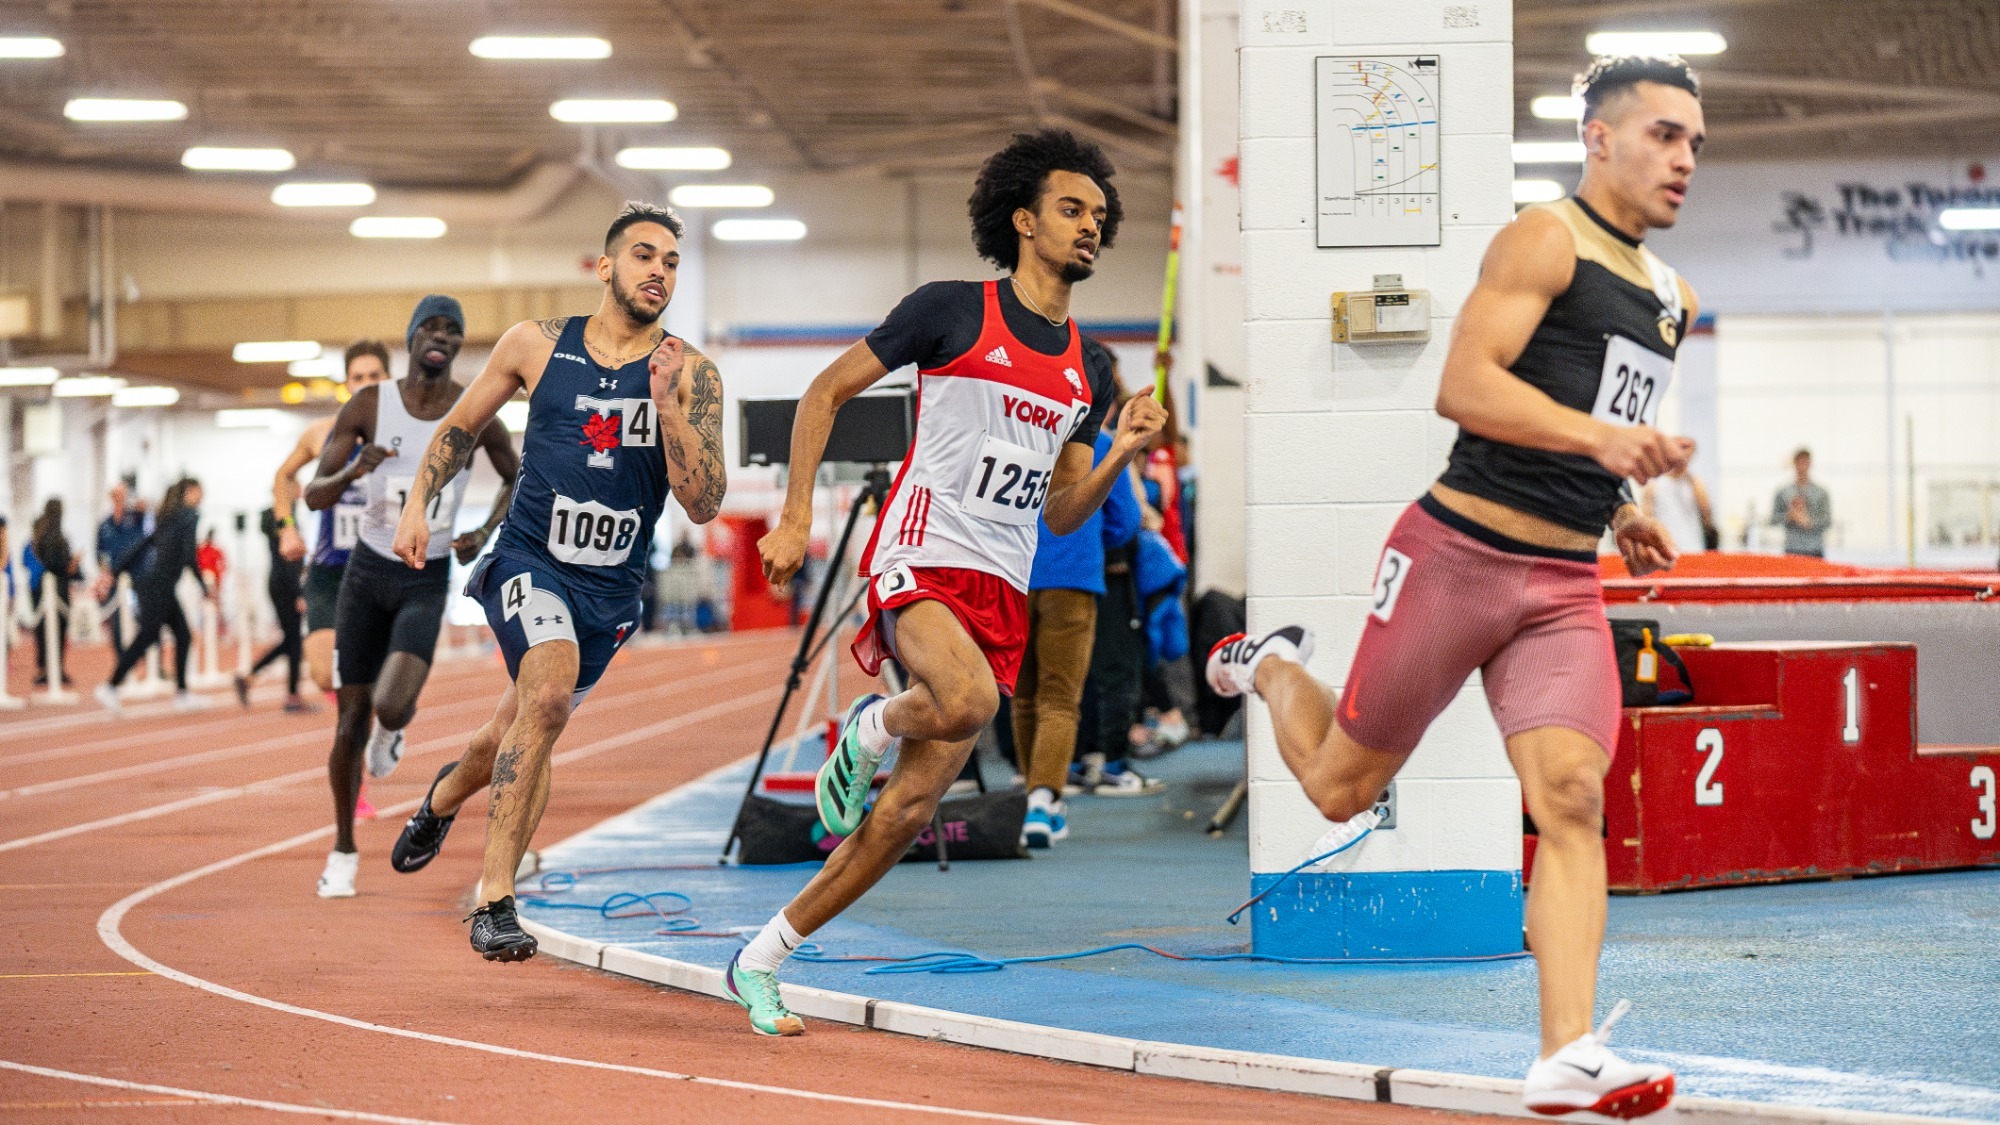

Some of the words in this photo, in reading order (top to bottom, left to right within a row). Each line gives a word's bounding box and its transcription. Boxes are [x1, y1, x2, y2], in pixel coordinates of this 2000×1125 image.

[553, 352, 587, 365] OUA
[985, 354, 1013, 368] adidas
[1003, 394, 1065, 435] YORK
[1609, 363, 1654, 425] 262
[629, 401, 651, 444] 4
[556, 508, 635, 552] 1098
[506, 577, 526, 609] 4
[1375, 556, 1400, 610] 3
[1842, 667, 1860, 742] 1
[1695, 727, 1724, 806] 2
[1969, 766, 1997, 839] 3
